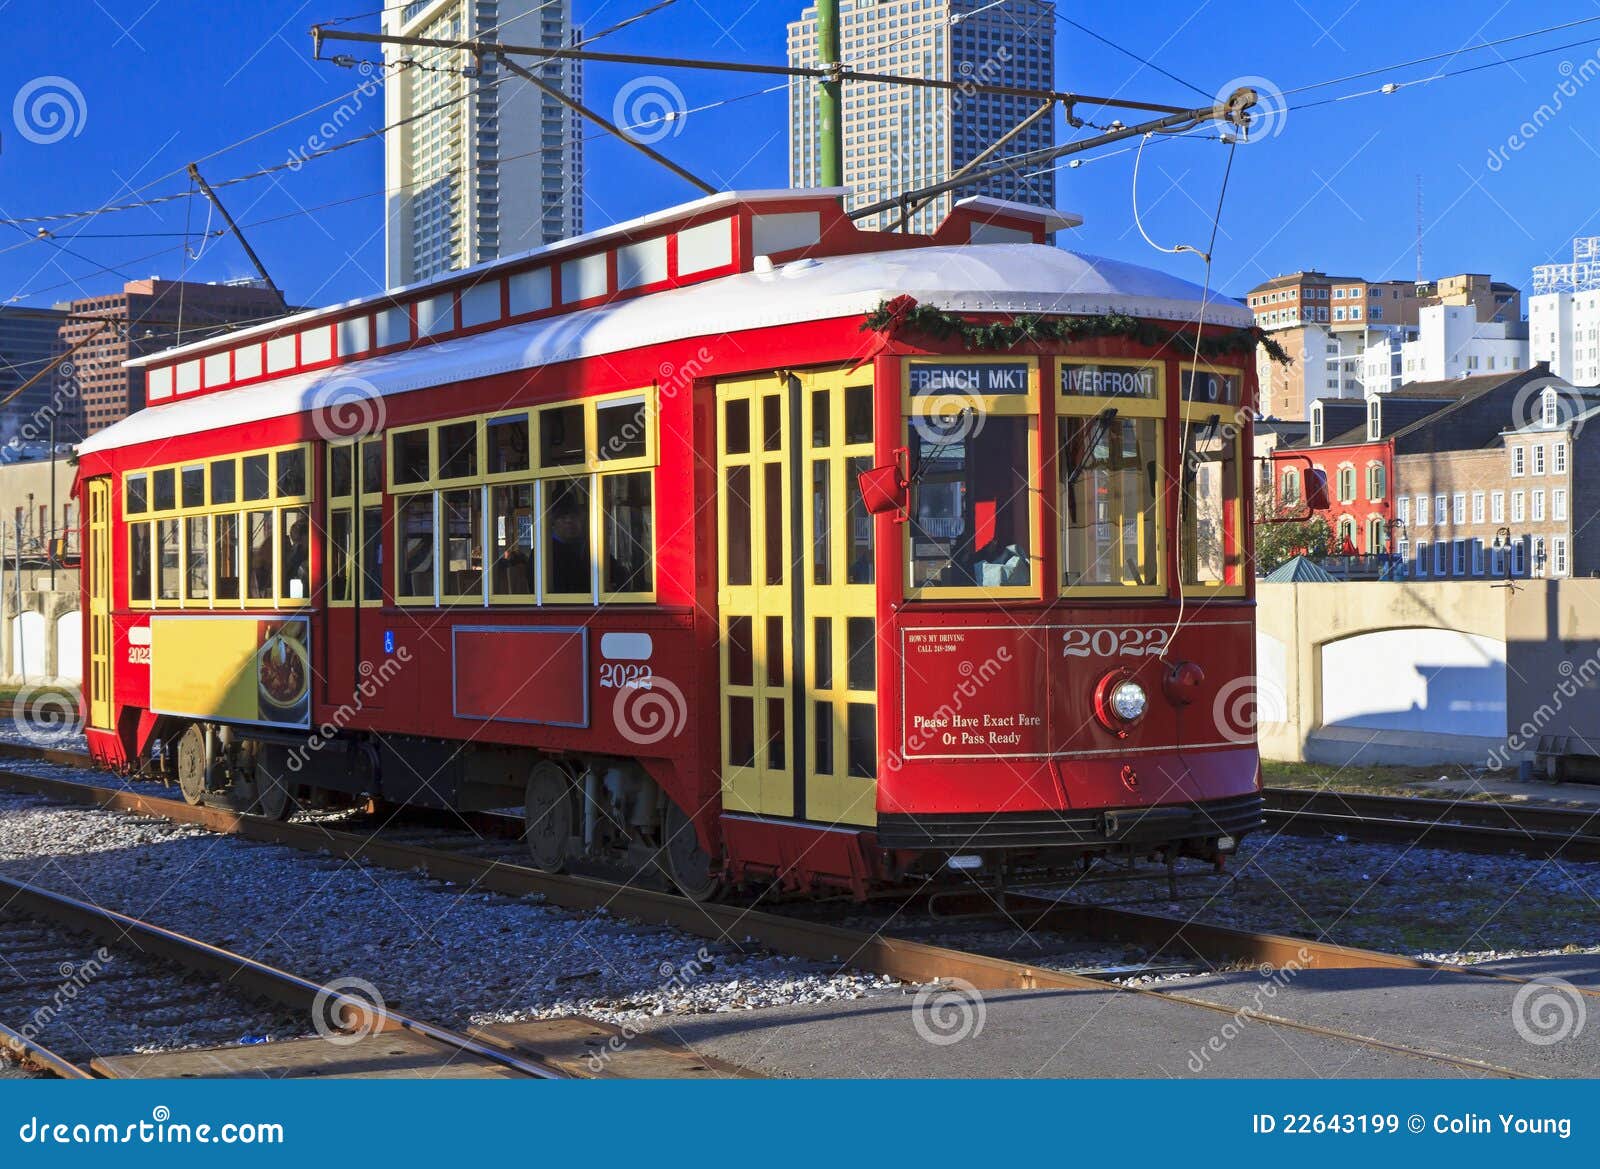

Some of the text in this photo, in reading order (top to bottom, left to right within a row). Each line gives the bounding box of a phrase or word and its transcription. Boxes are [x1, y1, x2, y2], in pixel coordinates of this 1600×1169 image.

[910, 369, 1027, 390] FRENCH MKT
[1061, 370, 1153, 394] RIVERFRONT
[928, 634, 937, 643] MY
[939, 634, 965, 642] DRIVING
[1062, 628, 1169, 658] 2022
[128, 646, 152, 664] 2022
[917, 645, 933, 653] CALL
[599, 663, 653, 690] 2022
[913, 713, 1041, 728] Please Have Exact Fare
[942, 731, 1022, 746] Or Pass Ready
